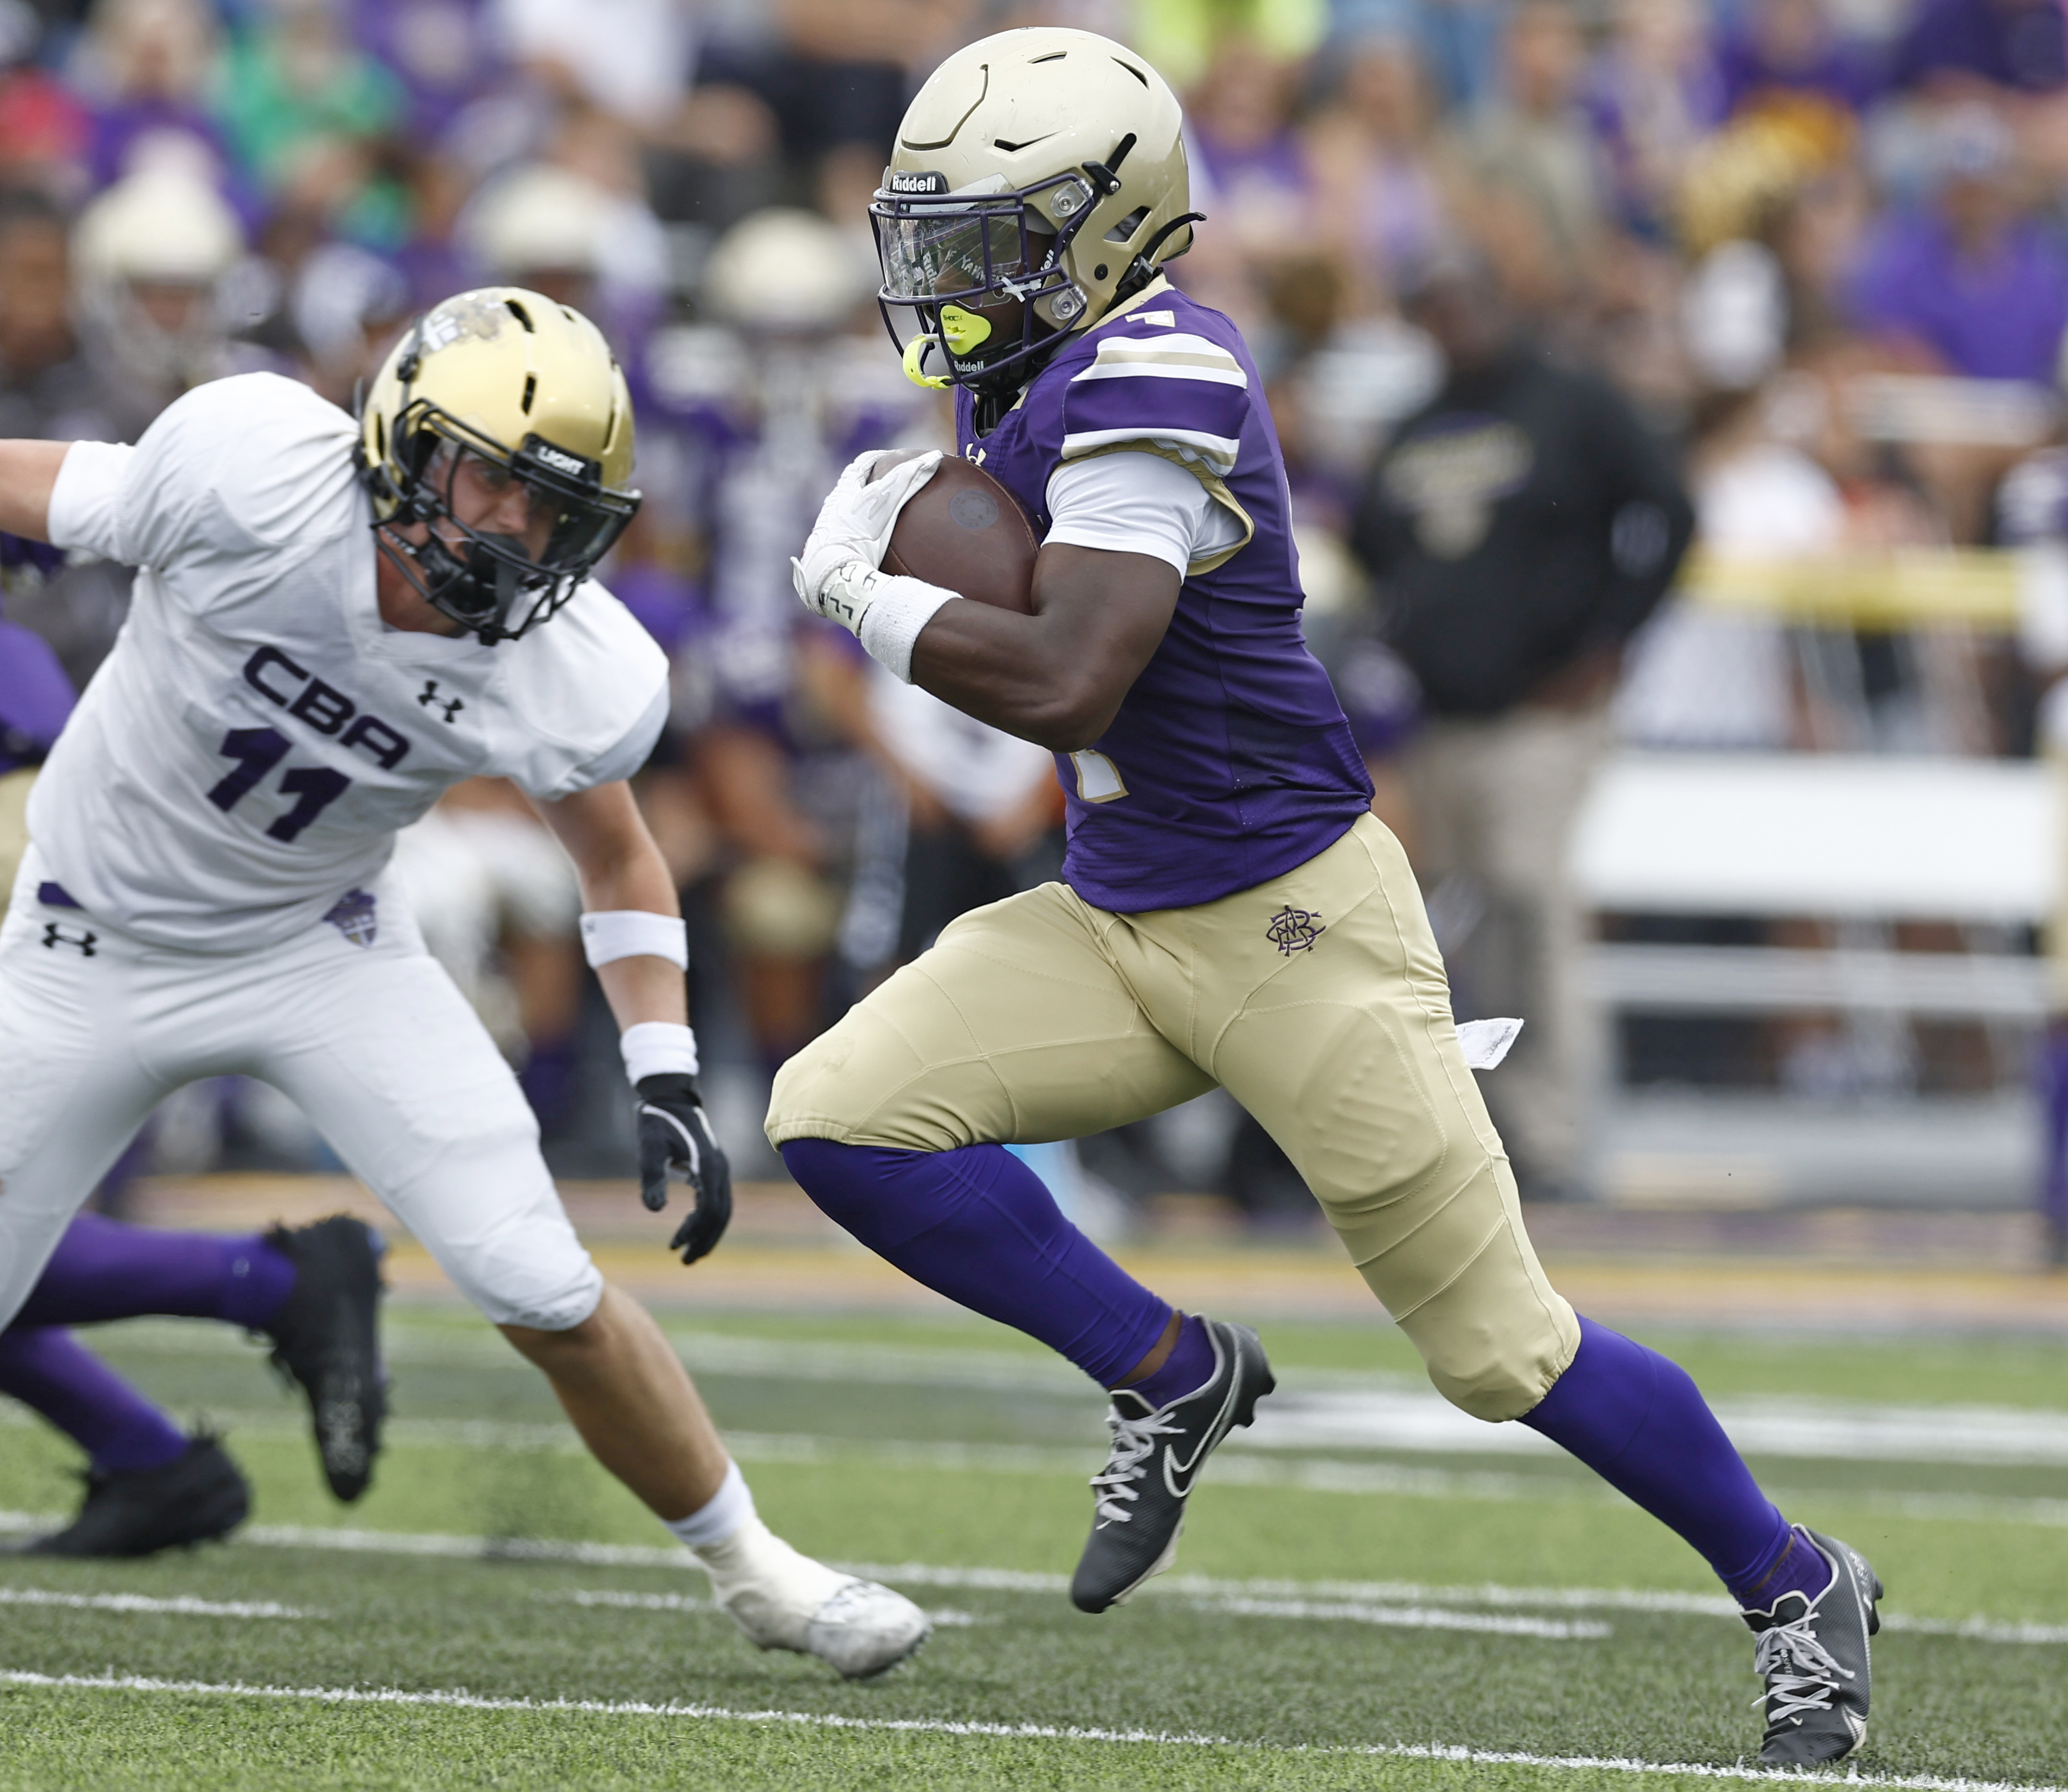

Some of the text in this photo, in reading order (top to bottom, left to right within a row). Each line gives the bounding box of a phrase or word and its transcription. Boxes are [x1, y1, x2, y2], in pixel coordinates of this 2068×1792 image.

[893, 175, 936, 192] Riddell
[954, 360, 984, 373] Riddell
[243, 645, 411, 770] CBA
[207, 727, 352, 843] 11
